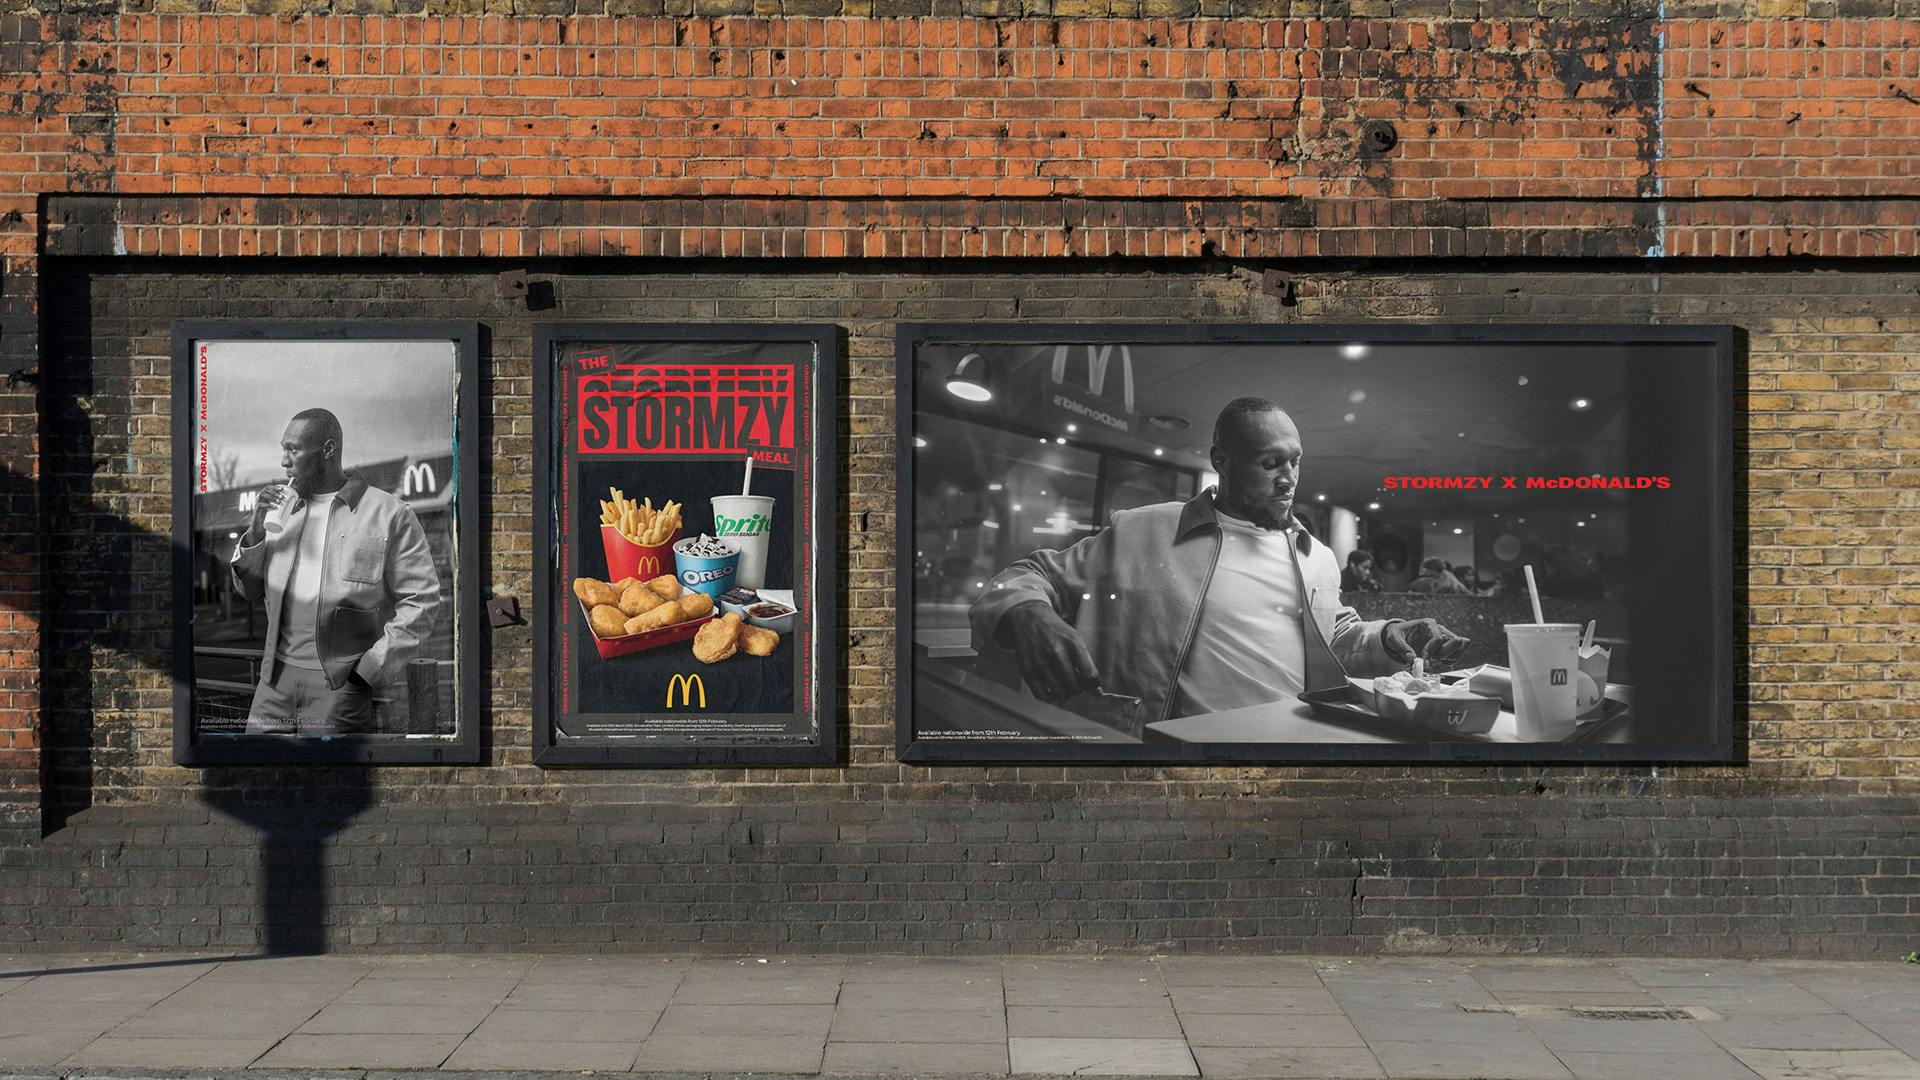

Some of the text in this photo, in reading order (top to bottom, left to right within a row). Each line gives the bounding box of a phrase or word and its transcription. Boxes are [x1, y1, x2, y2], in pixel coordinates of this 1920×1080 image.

[578, 355, 609, 370] THE
[200, 345, 208, 492] STORMZY X McDONALD'S
[583, 395, 789, 449] STORMZY
[752, 450, 790, 464] MEAL
[1383, 476, 1671, 489] STORMZY X McDONALD'S
[682, 565, 735, 585] OREO
